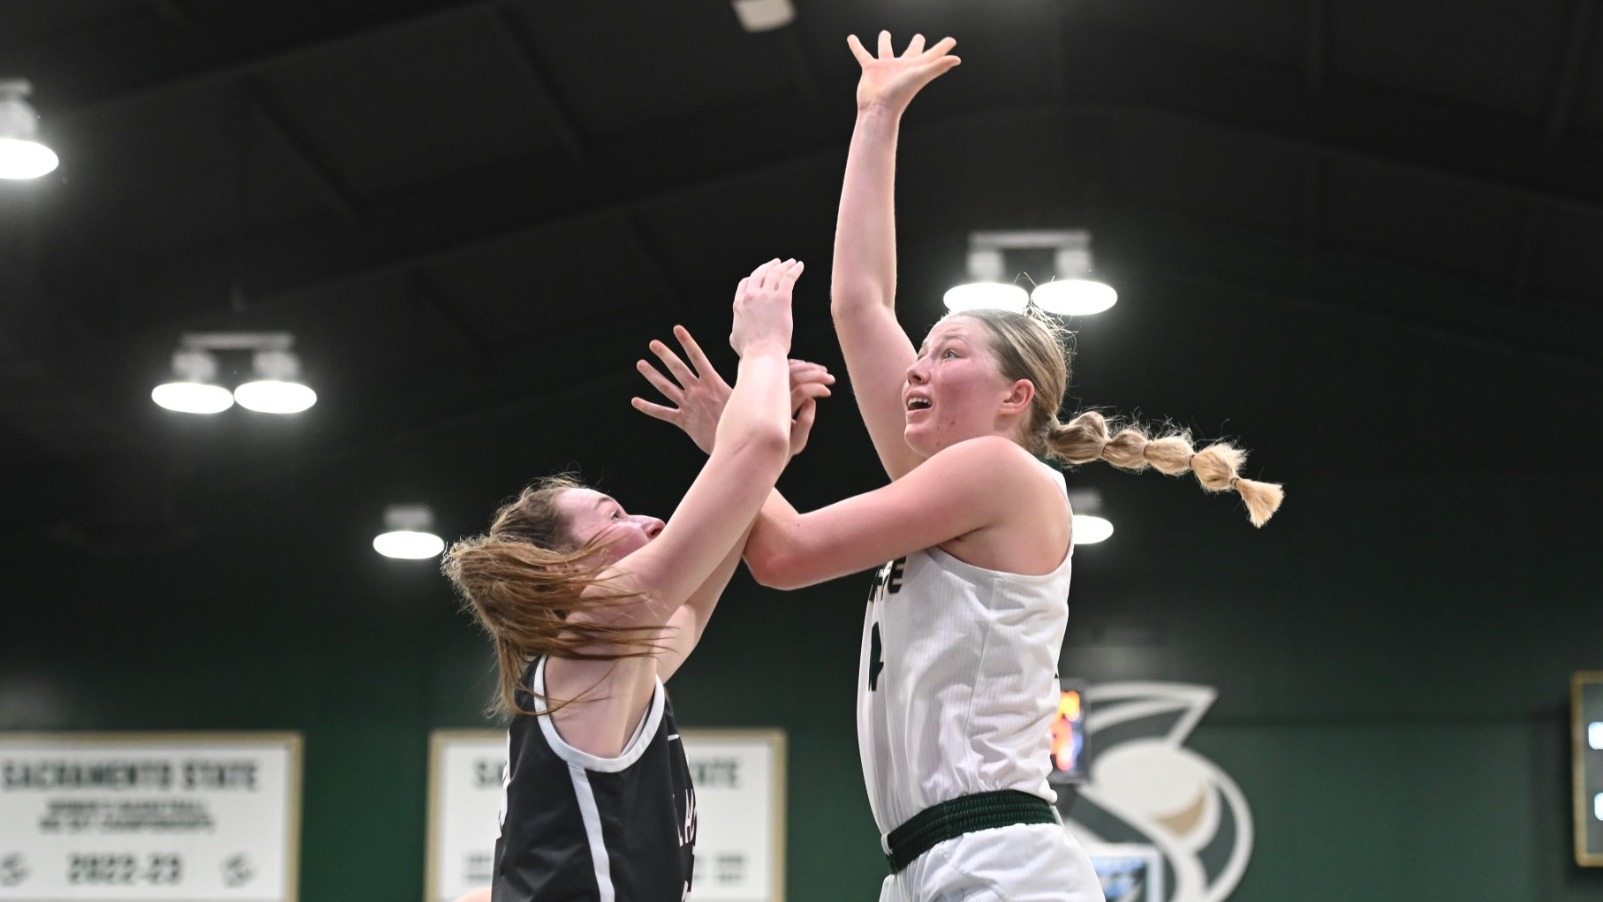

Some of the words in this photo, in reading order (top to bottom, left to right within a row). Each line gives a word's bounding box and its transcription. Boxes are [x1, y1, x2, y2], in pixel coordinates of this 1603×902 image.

[2, 760, 172, 790] SACRAMENTO
[182, 760, 258, 790] STATE
[69, 853, 182, 884] 2022-23
